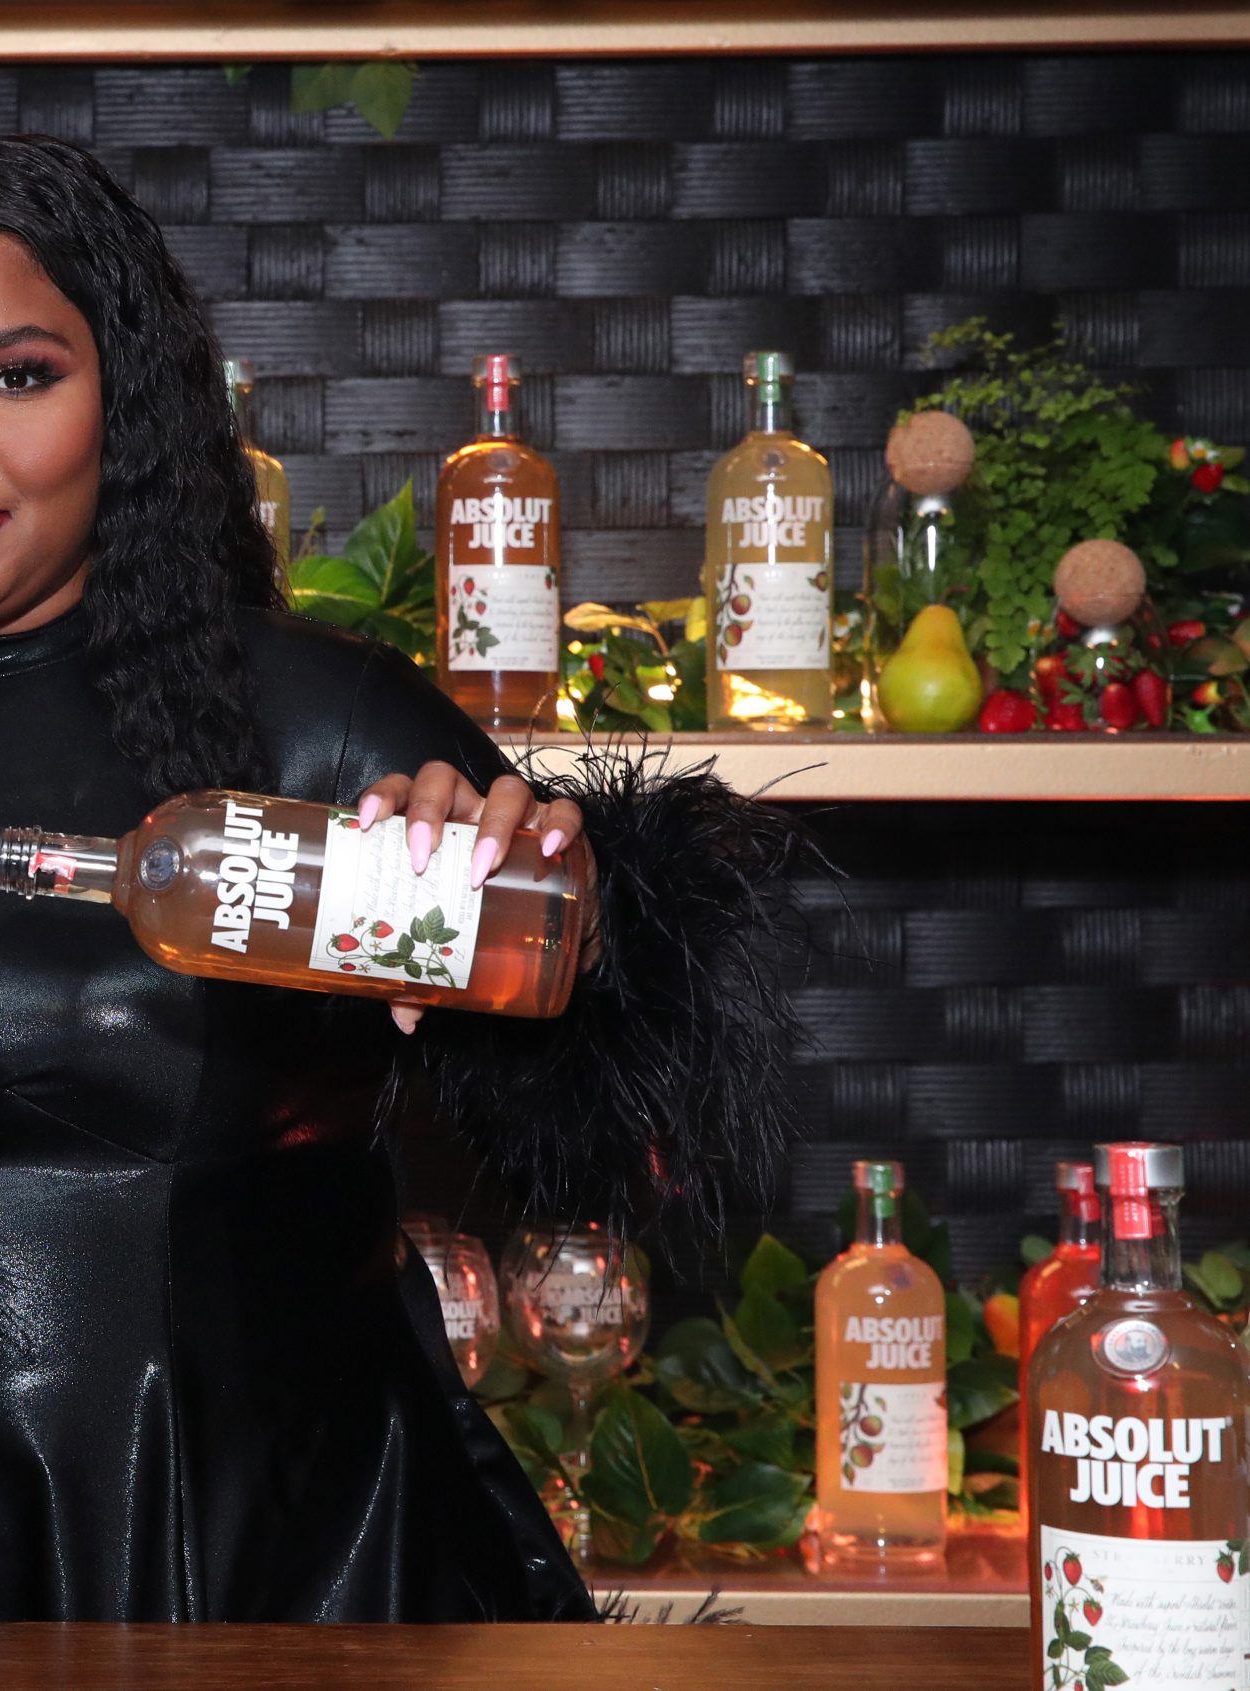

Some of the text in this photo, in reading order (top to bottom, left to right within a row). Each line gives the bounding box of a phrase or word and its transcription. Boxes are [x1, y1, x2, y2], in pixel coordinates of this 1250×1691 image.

[451, 497, 551, 524] ABSOLUT
[722, 496, 824, 523] ABSOLUT
[468, 522, 534, 548] JUICE
[739, 521, 806, 547] JUICE
[211, 800, 263, 953] ABSOLUT
[253, 829, 299, 930] JUICE
[845, 1316, 942, 1343] ABSOLUT
[865, 1342, 932, 1369] JUICE
[1041, 1409, 1226, 1464] ABSOLUT
[1070, 1458, 1190, 1509] JUICE
